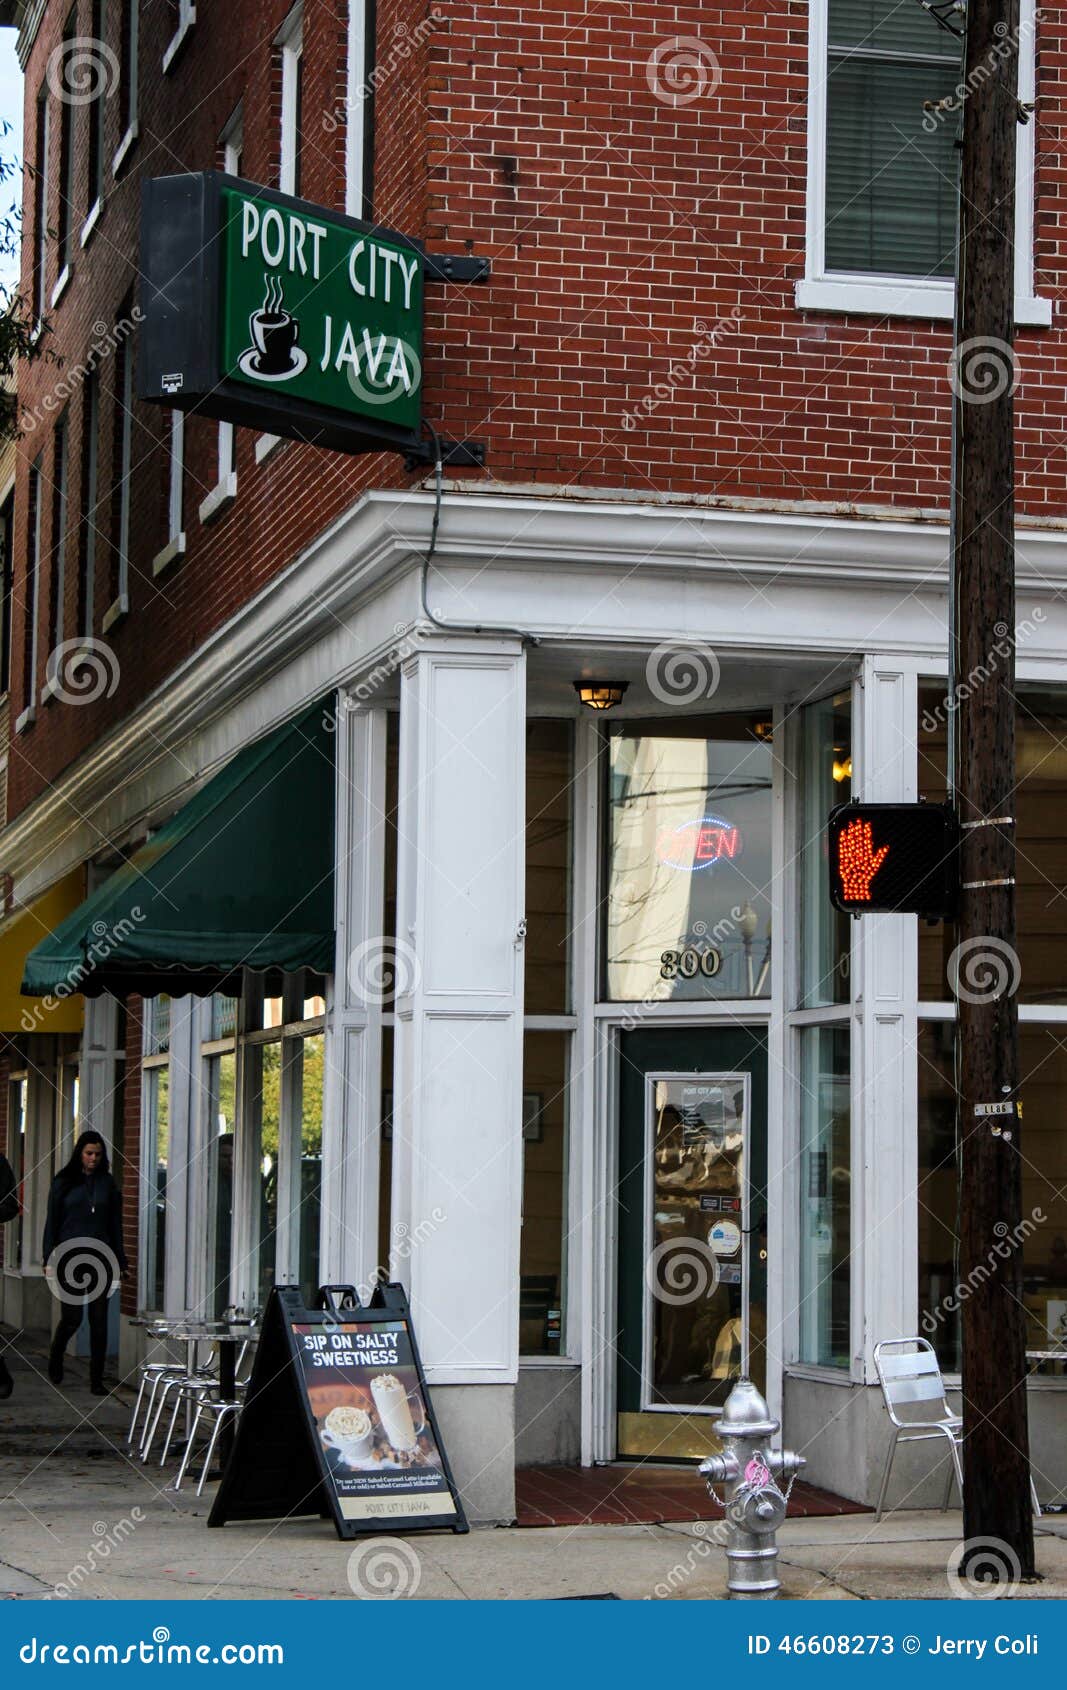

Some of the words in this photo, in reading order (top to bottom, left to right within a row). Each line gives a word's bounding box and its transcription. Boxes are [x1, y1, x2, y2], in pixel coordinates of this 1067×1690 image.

[242, 200, 328, 280] PORT
[349, 239, 418, 309] CITY
[320, 315, 412, 392] JAVA
[656, 829, 739, 859] OPEN
[660, 949, 721, 979] 300
[304, 1335, 327, 1350] SIP
[331, 1334, 352, 1349] ON
[356, 1332, 398, 1349] SALTY
[312, 1350, 398, 1366] SWEETNESS
[407, 1501, 430, 1512] JAVA
